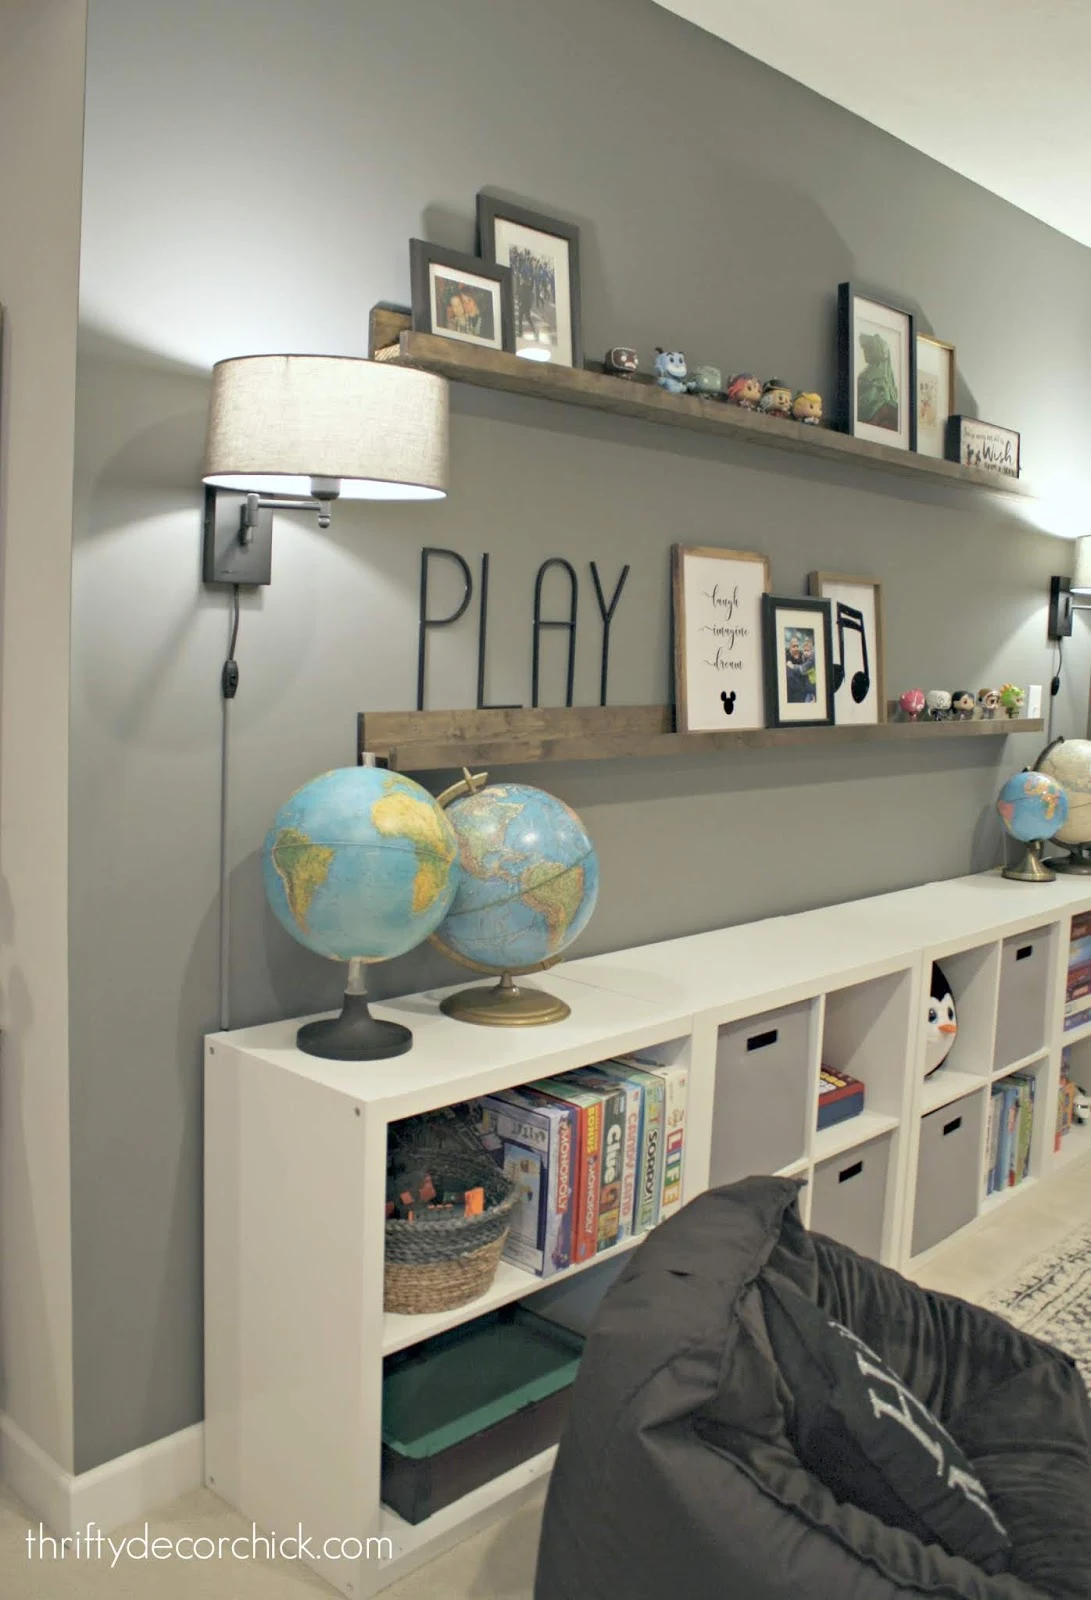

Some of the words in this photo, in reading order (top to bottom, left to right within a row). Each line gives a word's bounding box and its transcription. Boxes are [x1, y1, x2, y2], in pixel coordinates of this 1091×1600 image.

[982, 440, 1013, 465] Wish
[416, 547, 631, 711] PLAY
[701, 583, 740, 621] laugh
[698, 624, 750, 650] imagine
[703, 647, 743, 671] dream
[557, 1129, 571, 1211] MONOPOLY
[604, 1123, 622, 1184] Clue
[663, 1130, 683, 1205] LIFE
[585, 1165, 597, 1234] MONOPOLY
